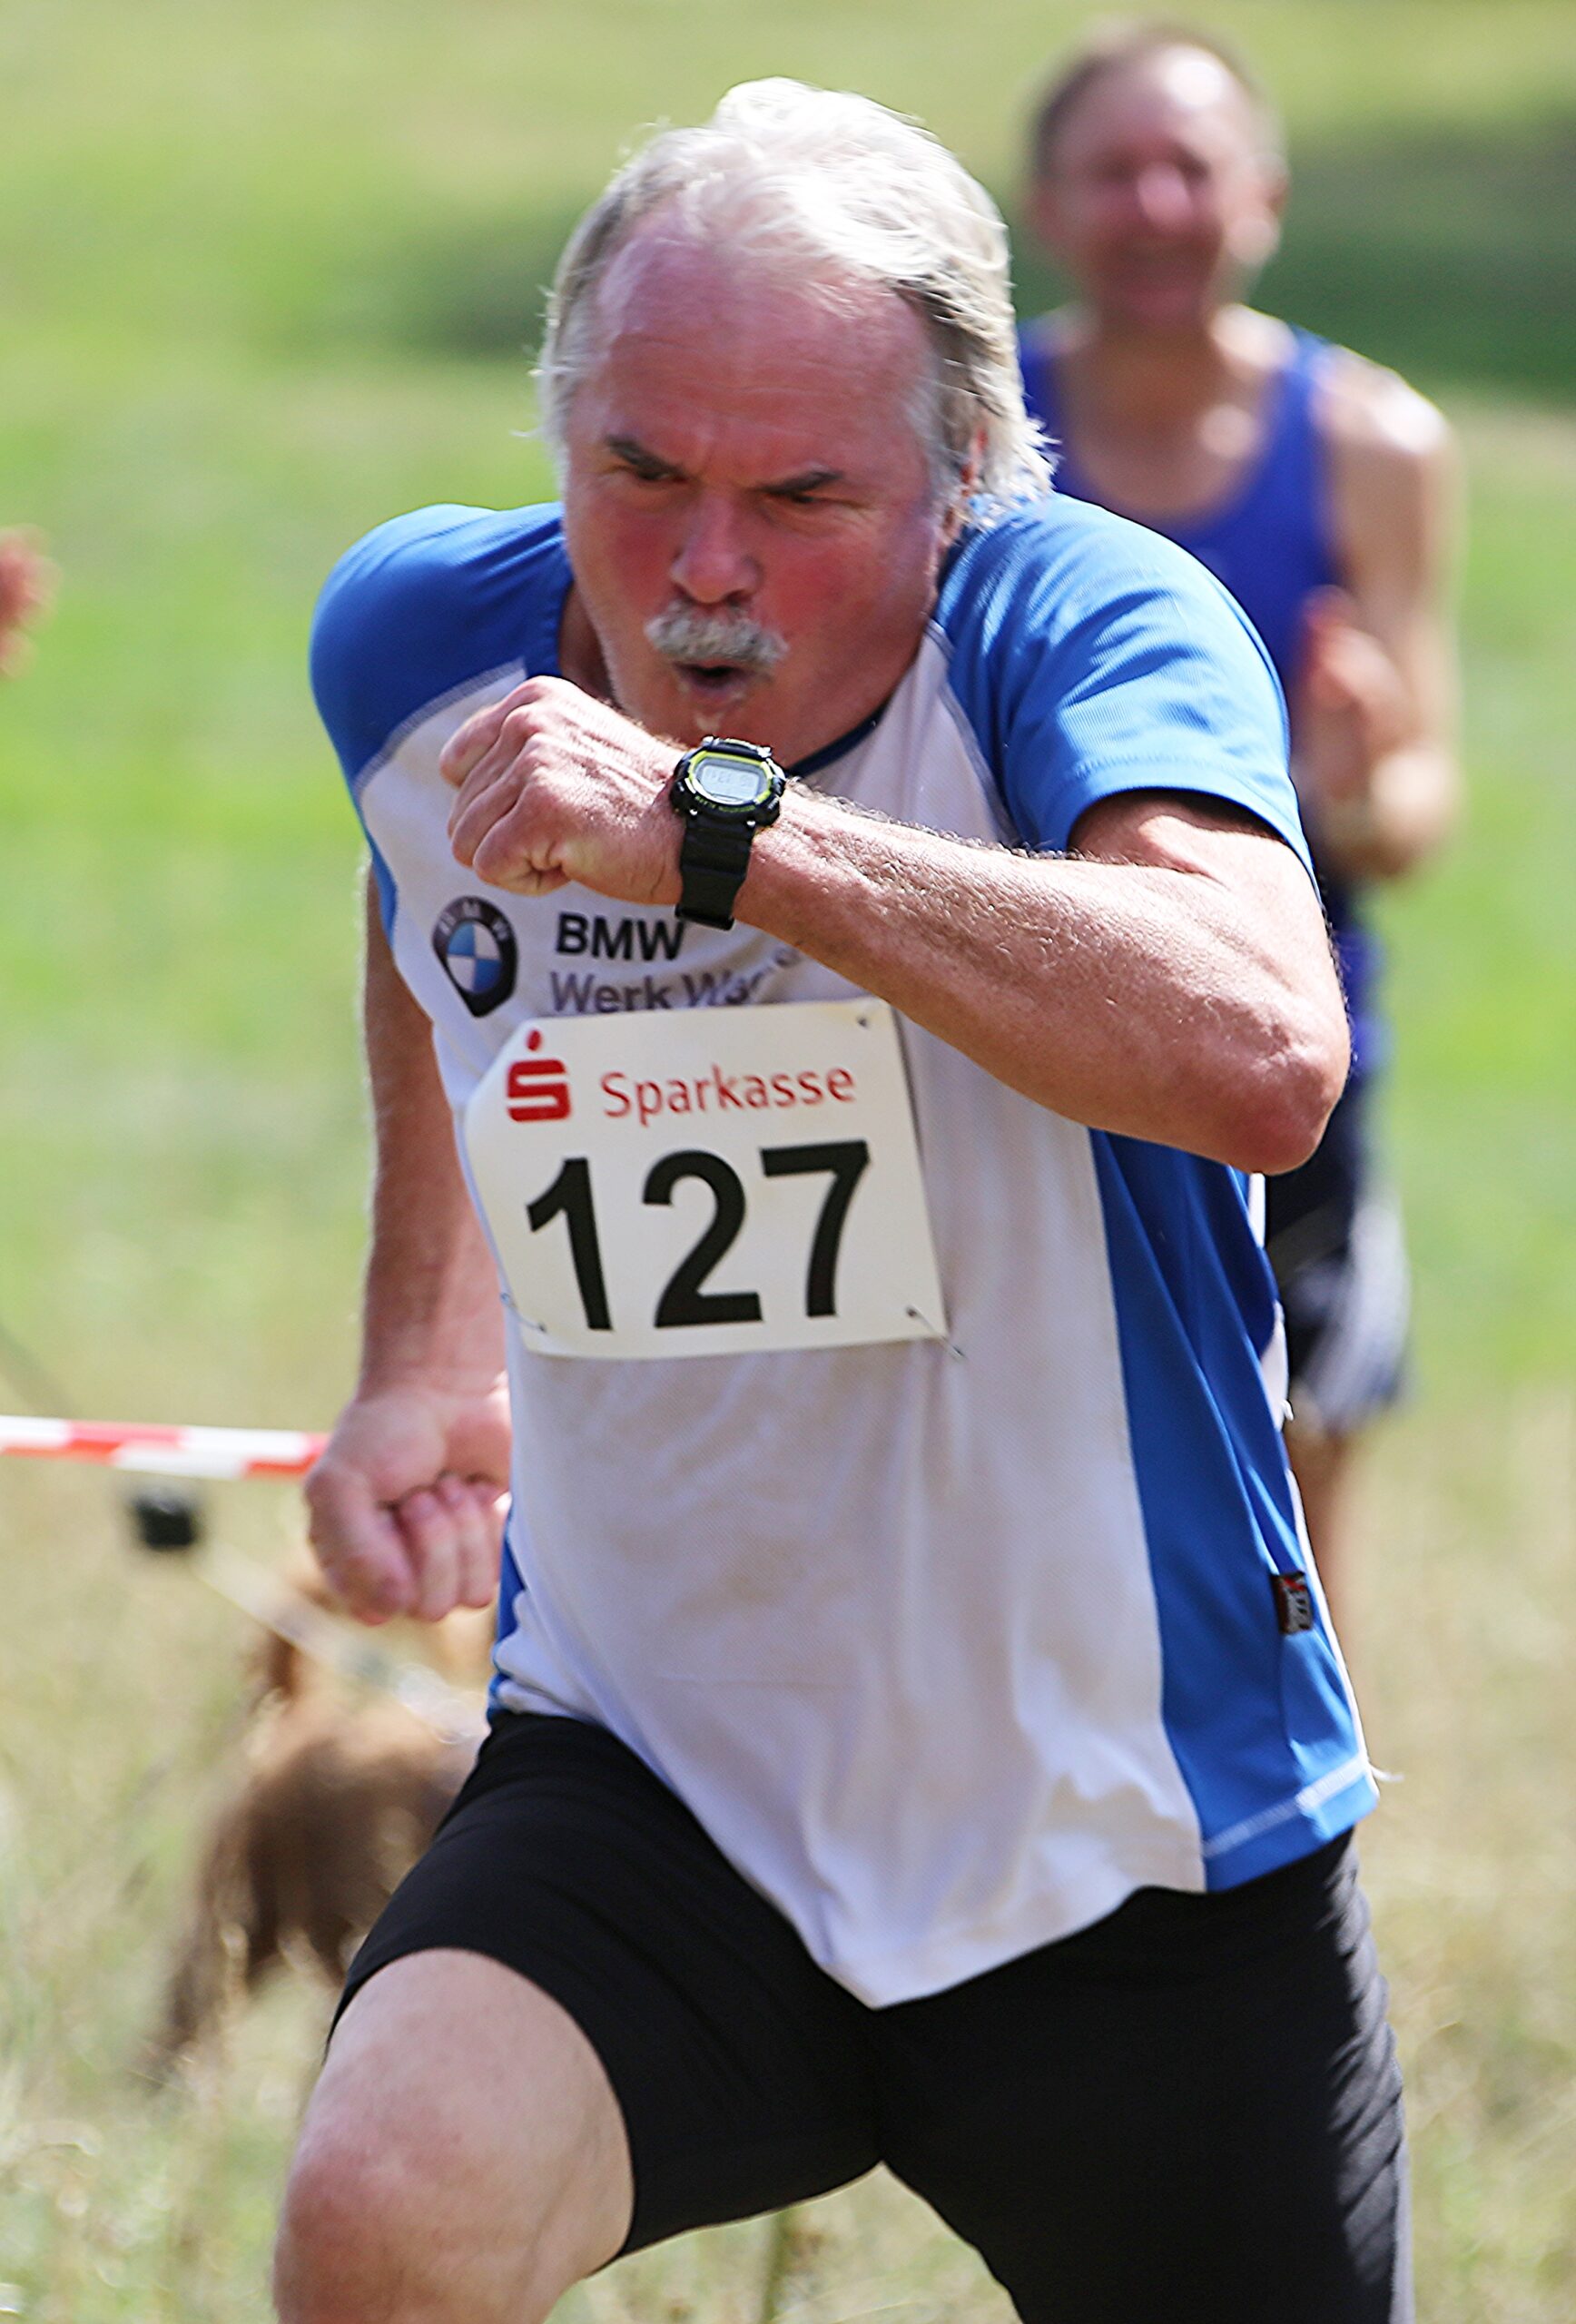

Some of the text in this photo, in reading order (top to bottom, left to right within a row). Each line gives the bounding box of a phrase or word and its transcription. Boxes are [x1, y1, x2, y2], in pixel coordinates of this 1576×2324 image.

[556, 911, 685, 960] BMW
[550, 970, 672, 1013] Werk
[600, 1065, 856, 1126] Sparkasse
[526, 1139, 870, 1331] 127
